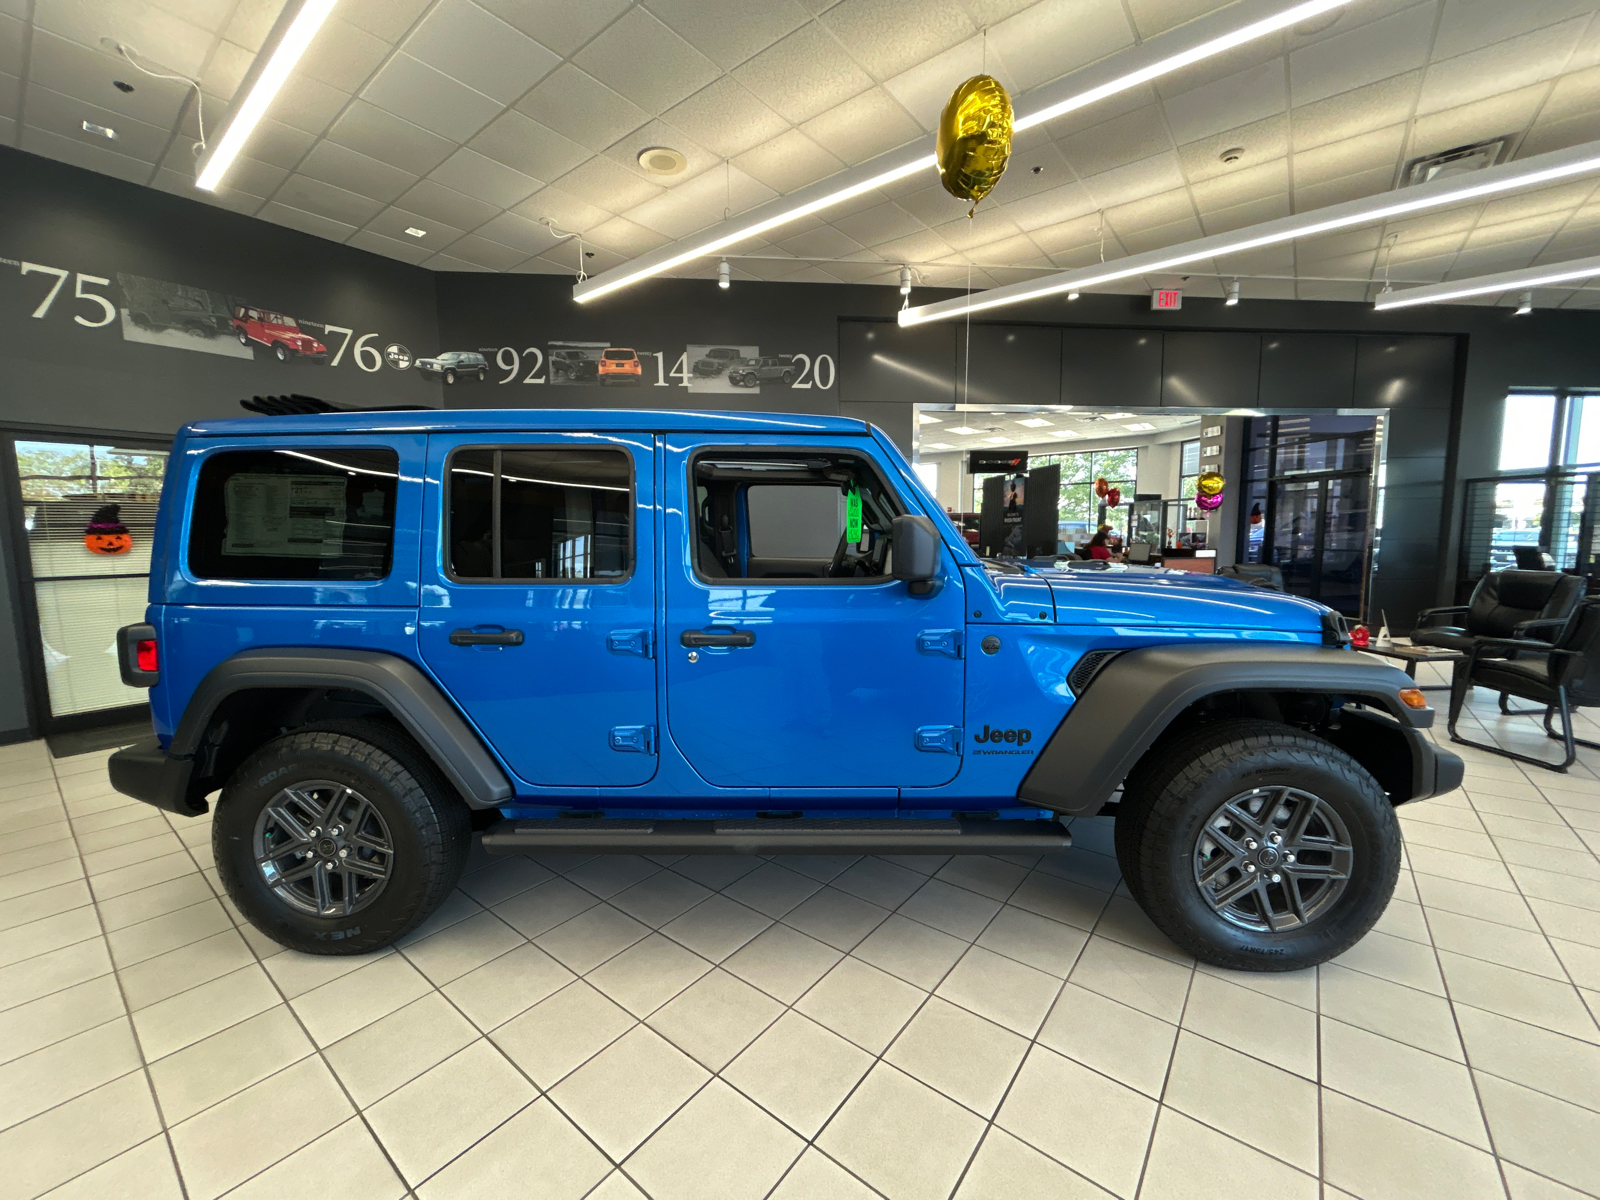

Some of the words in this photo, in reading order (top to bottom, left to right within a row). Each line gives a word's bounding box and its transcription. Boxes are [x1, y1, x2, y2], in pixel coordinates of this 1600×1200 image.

[21, 261, 116, 328] 75
[1158, 291, 1179, 307] EXIT
[298, 319, 325, 329] nineteen
[324, 324, 382, 373] 76
[389, 352, 409, 361] Jeep
[496, 346, 546, 385] 92
[653, 351, 693, 387] 14
[791, 353, 836, 390] 20
[974, 725, 1032, 746] Jeep
